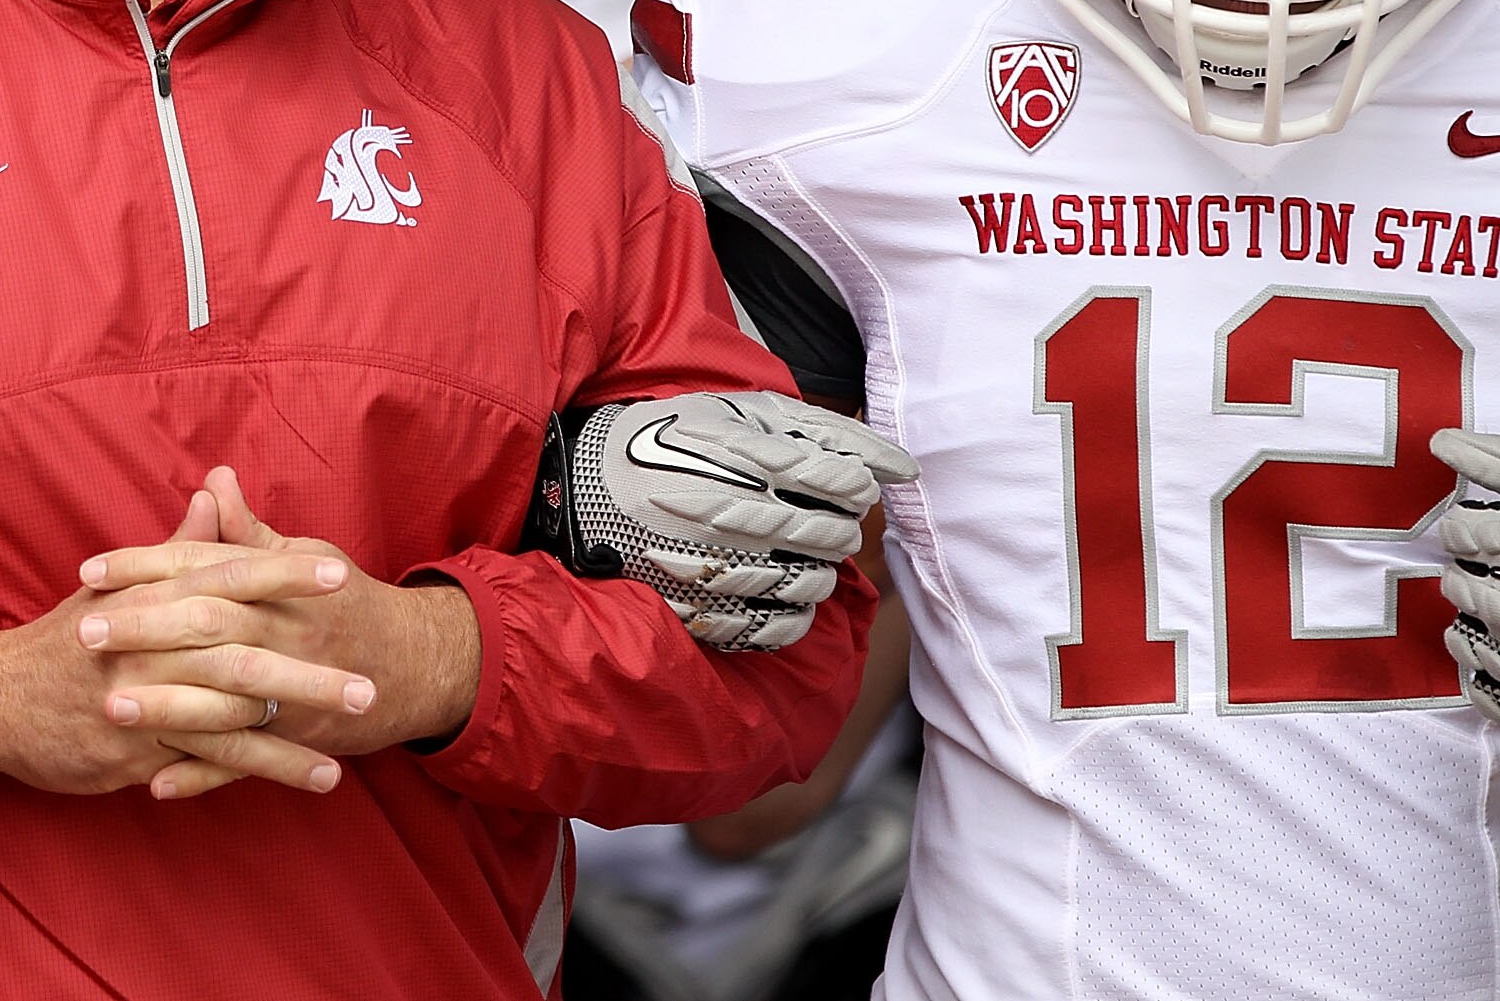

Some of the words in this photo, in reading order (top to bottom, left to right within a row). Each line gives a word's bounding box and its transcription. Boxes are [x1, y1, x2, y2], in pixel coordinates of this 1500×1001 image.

[991, 45, 1076, 109] PAC
[1200, 59, 1267, 78] Riddell
[1010, 88, 1060, 129] 10
[958, 192, 1355, 264] WASHINGTON
[1373, 207, 1500, 278] STAT
[1032, 284, 1476, 722] 12
